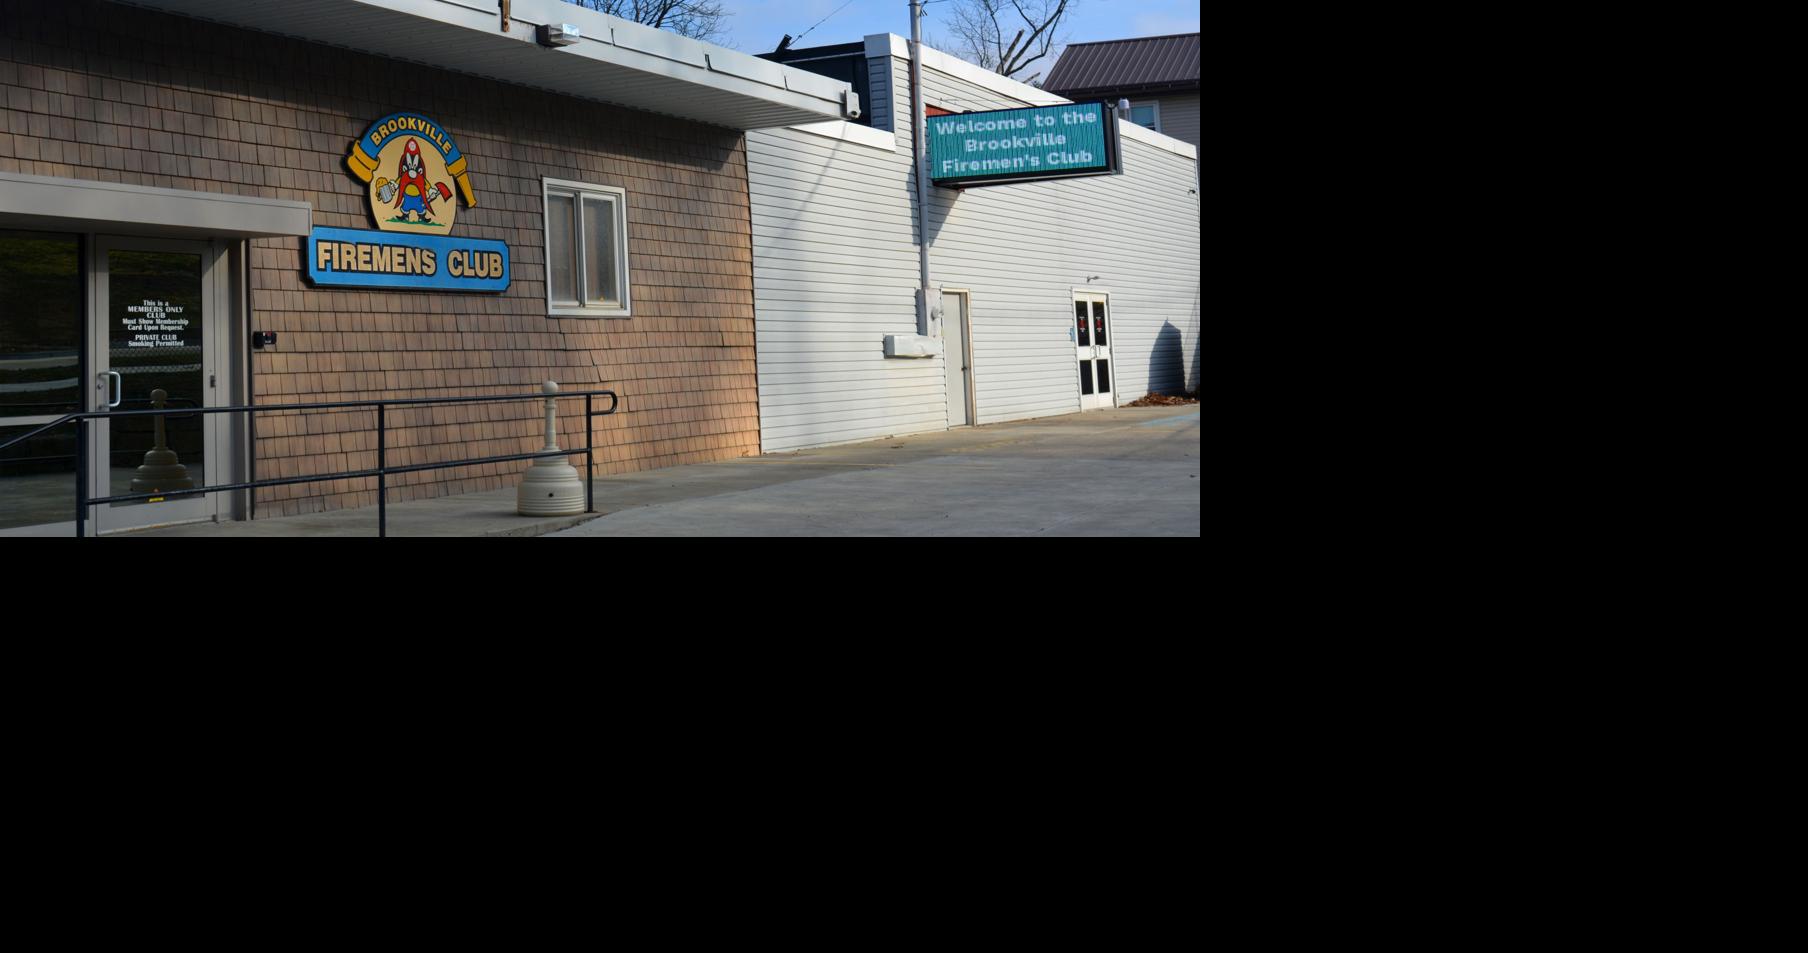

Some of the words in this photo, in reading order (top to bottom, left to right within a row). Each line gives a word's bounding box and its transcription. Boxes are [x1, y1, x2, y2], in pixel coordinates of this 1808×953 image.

[936, 116, 1027, 135] Welcome
[1034, 114, 1056, 127] to
[1062, 111, 1097, 125] the
[370, 116, 452, 154] BROOKVILLE
[964, 133, 1066, 152] Brookville
[942, 154, 1040, 173] Firemen's
[1047, 150, 1093, 164] Club
[316, 240, 436, 275] FIREMENS
[448, 250, 504, 279] CLUB
[155, 318, 189, 326] Membership
